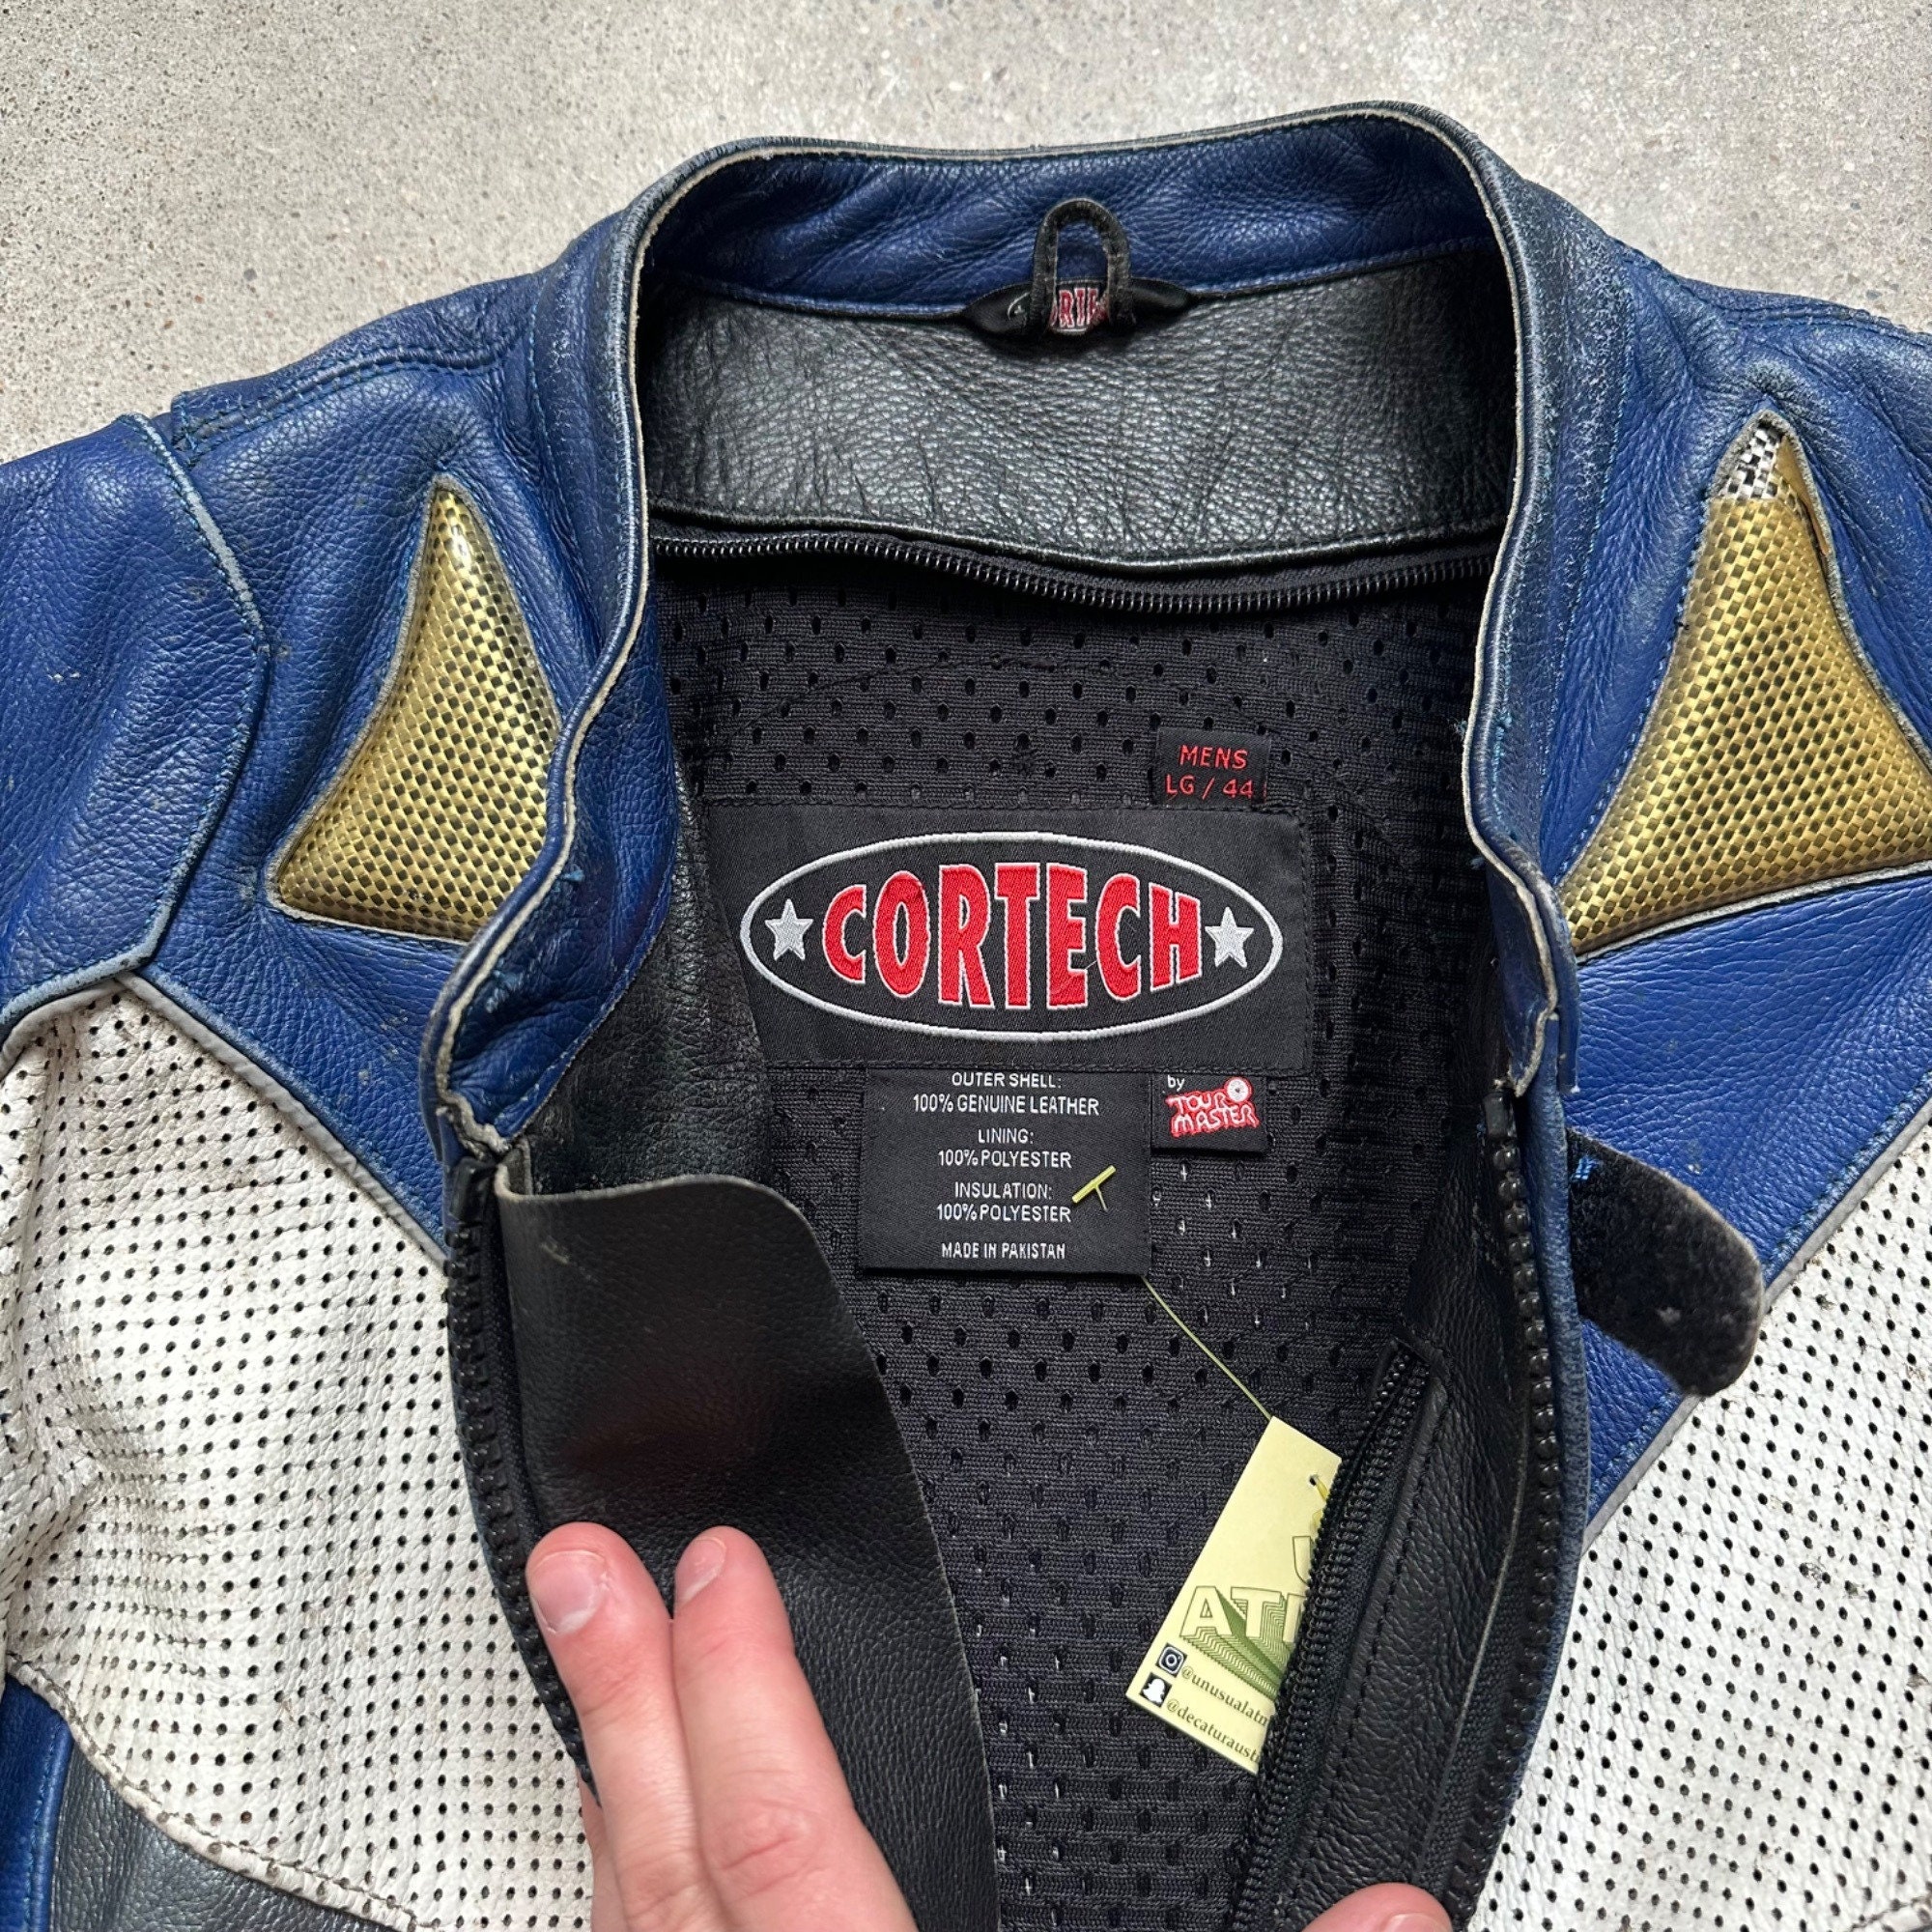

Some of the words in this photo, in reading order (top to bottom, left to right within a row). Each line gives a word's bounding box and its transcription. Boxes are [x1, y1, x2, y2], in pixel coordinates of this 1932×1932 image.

[1179, 744, 1248, 770] MENS
[1166, 774, 1196, 796] LG
[1223, 778, 1254, 800] 44
[822, 862, 1202, 1009] CORTECH
[952, 1071, 1006, 1088] OUTER
[1009, 1072, 1063, 1089] SHELL:
[1167, 1074, 1185, 1092] by
[913, 1094, 954, 1113] 100%
[957, 1095, 1026, 1114] GENUINE
[1030, 1096, 1100, 1116] LEATHER
[1166, 1093, 1227, 1115] TOUR
[1173, 1104, 1260, 1135] MASTER
[978, 1127, 1035, 1145] LINING:
[938, 1149, 979, 1167] 100%
[980, 1151, 1072, 1169] POLYESTER
[954, 1181, 1054, 1200] INSULATION:
[936, 1204, 978, 1222] 100%
[980, 1205, 1071, 1223] POLYESTER
[941, 1242, 979, 1259] MADE
[983, 1242, 997, 1259] IN
[1001, 1242, 1065, 1260] PAKISTAN
